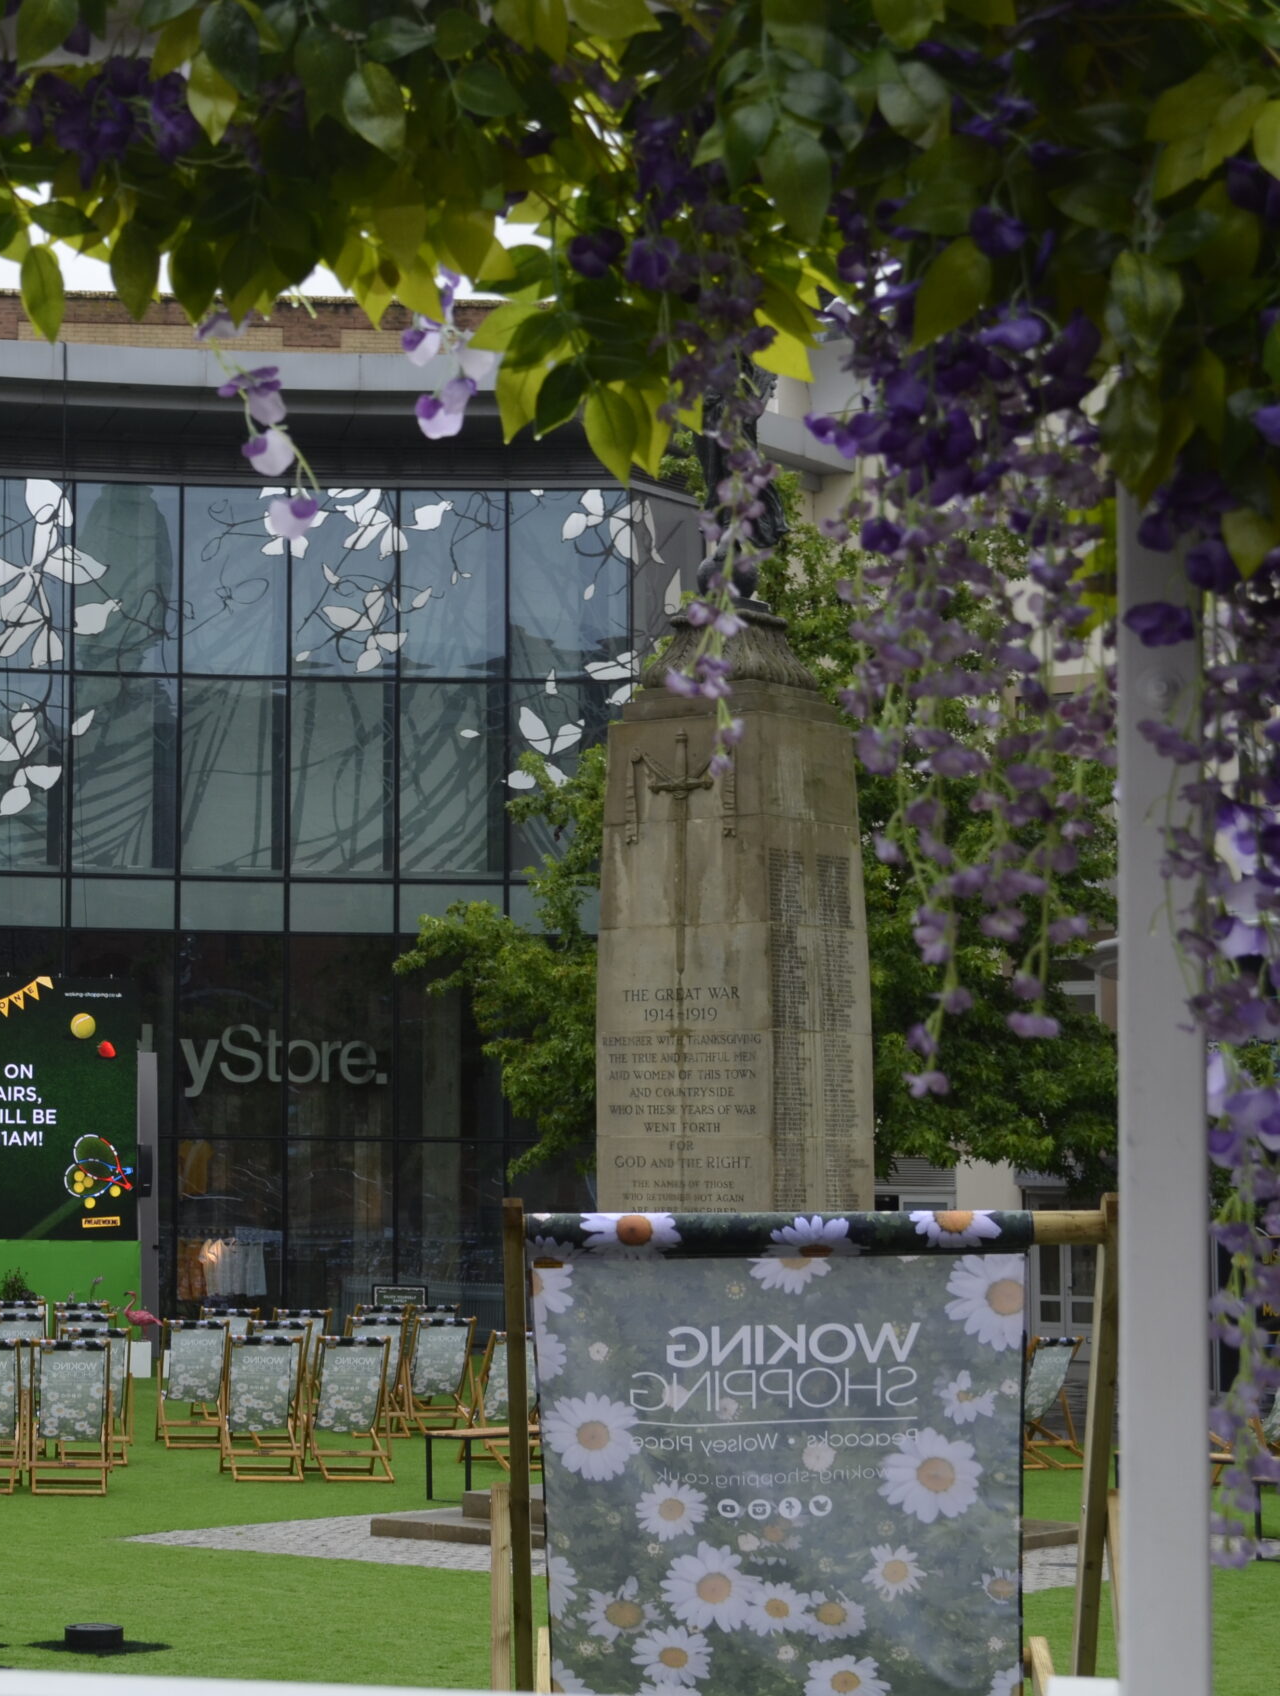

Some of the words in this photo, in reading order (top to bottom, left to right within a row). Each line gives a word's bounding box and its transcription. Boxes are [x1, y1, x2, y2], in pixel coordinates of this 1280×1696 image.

[622, 989, 649, 1002] THE
[655, 987, 701, 1001] GREAT
[708, 986, 741, 1000] WAR
[602, 1035, 652, 1047] REMEMBER
[687, 1033, 762, 1046] THANKSGIVING
[608, 1053, 628, 1064] THE
[632, 1053, 657, 1064] TRUE
[660, 1053, 680, 1063] AND
[683, 1052, 730, 1063] FAITHFUL
[734, 1051, 756, 1062] MEN
[4, 1063, 34, 1080] ON
[633, 1070, 675, 1081] WOMEN
[678, 1069, 692, 1080] OF
[698, 1069, 720, 1080] THIS
[724, 1069, 757, 1080] TOWN
[629, 1088, 652, 1098] AND
[655, 1087, 735, 1099] COUNTRYSIDE
[609, 1104, 633, 1116] WHO
[647, 1104, 676, 1115] THESE
[680, 1104, 715, 1115] YEARS
[717, 1104, 731, 1115] OF
[734, 1104, 757, 1115] WAR
[32, 1109, 57, 1125] BE
[643, 1122, 676, 1133] WENT
[682, 1122, 721, 1133] FORTH
[669, 1140, 695, 1151] FOR
[614, 1155, 647, 1169] GOD
[650, 1158, 675, 1169] AND
[680, 1158, 703, 1169] THE
